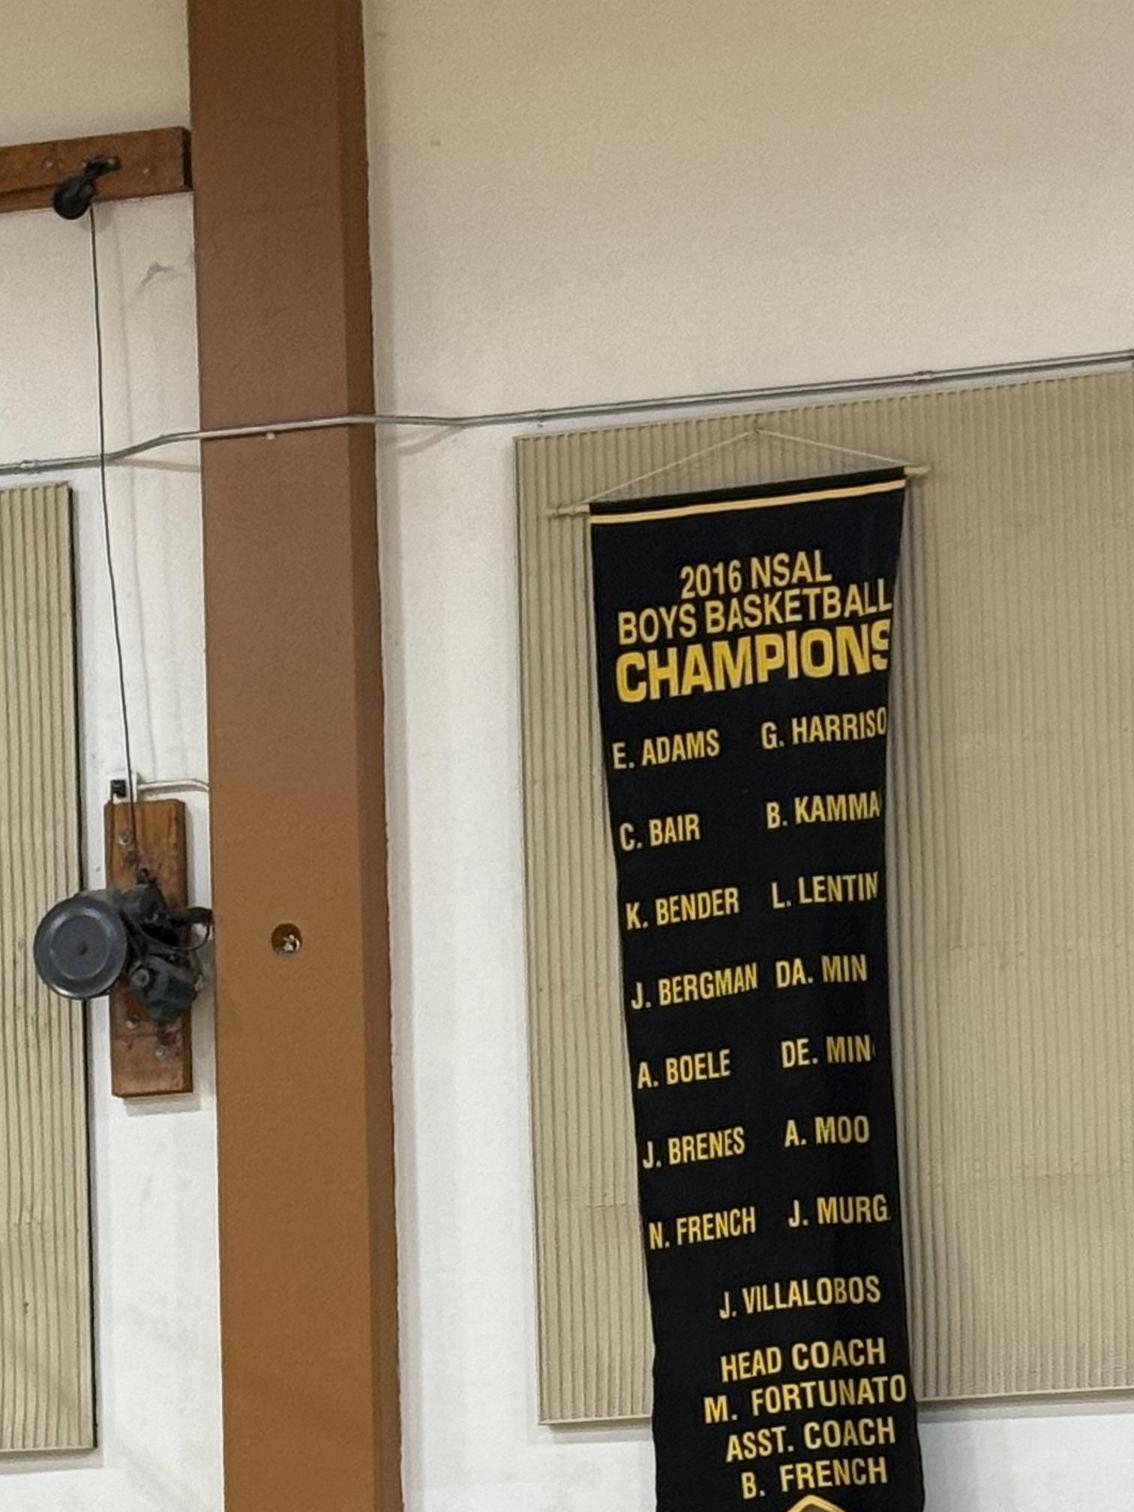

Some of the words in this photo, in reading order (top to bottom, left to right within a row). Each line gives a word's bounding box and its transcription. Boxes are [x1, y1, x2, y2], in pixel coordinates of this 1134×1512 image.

[681, 560, 741, 599] 2016
[751, 550, 832, 589] NSAL
[618, 603, 696, 644] BOYS
[705, 579, 892, 633] BASKETBALL
[615, 618, 891, 703] CHAMPIONS
[762, 722, 784, 749] G.
[792, 707, 886, 744] HARRISO
[613, 743, 634, 769] E.
[642, 729, 719, 766] ADAMS
[620, 823, 642, 851] C.
[649, 814, 700, 846] BAIR
[767, 802, 787, 828] B.
[626, 902, 648, 929] K.
[656, 888, 739, 925] BENDER
[772, 883, 791, 908] L.
[799, 872, 877, 903] LENTIN
[631, 982, 651, 1009] J.
[659, 963, 757, 1005] BERGMAN
[776, 958, 813, 988] DA.
[822, 955, 866, 982] MIN
[638, 1062, 658, 1089] A.
[666, 1049, 730, 1084] BOELE
[782, 1038, 818, 1068] DE.
[827, 1035, 876, 1062] MIN
[643, 1141, 661, 1168] J.
[668, 1127, 745, 1165] BRENES
[785, 1120, 806, 1147] A.
[815, 1116, 869, 1143] MOO
[649, 1222, 669, 1249] N.
[677, 1207, 755, 1245] FRENCH
[789, 1200, 808, 1227] J.
[720, 1292, 736, 1319] J.
[742, 1276, 880, 1313] VILLALOBOS
[721, 1347, 782, 1382] HEAD
[792, 1338, 885, 1370] COACH
[704, 1395, 737, 1423] M.
[752, 1375, 906, 1416] FORTUNATO
[726, 1426, 794, 1462] ASST.
[804, 1417, 895, 1449] COACH
[741, 1471, 766, 1500] B.
[780, 1457, 887, 1492] FRENCH
